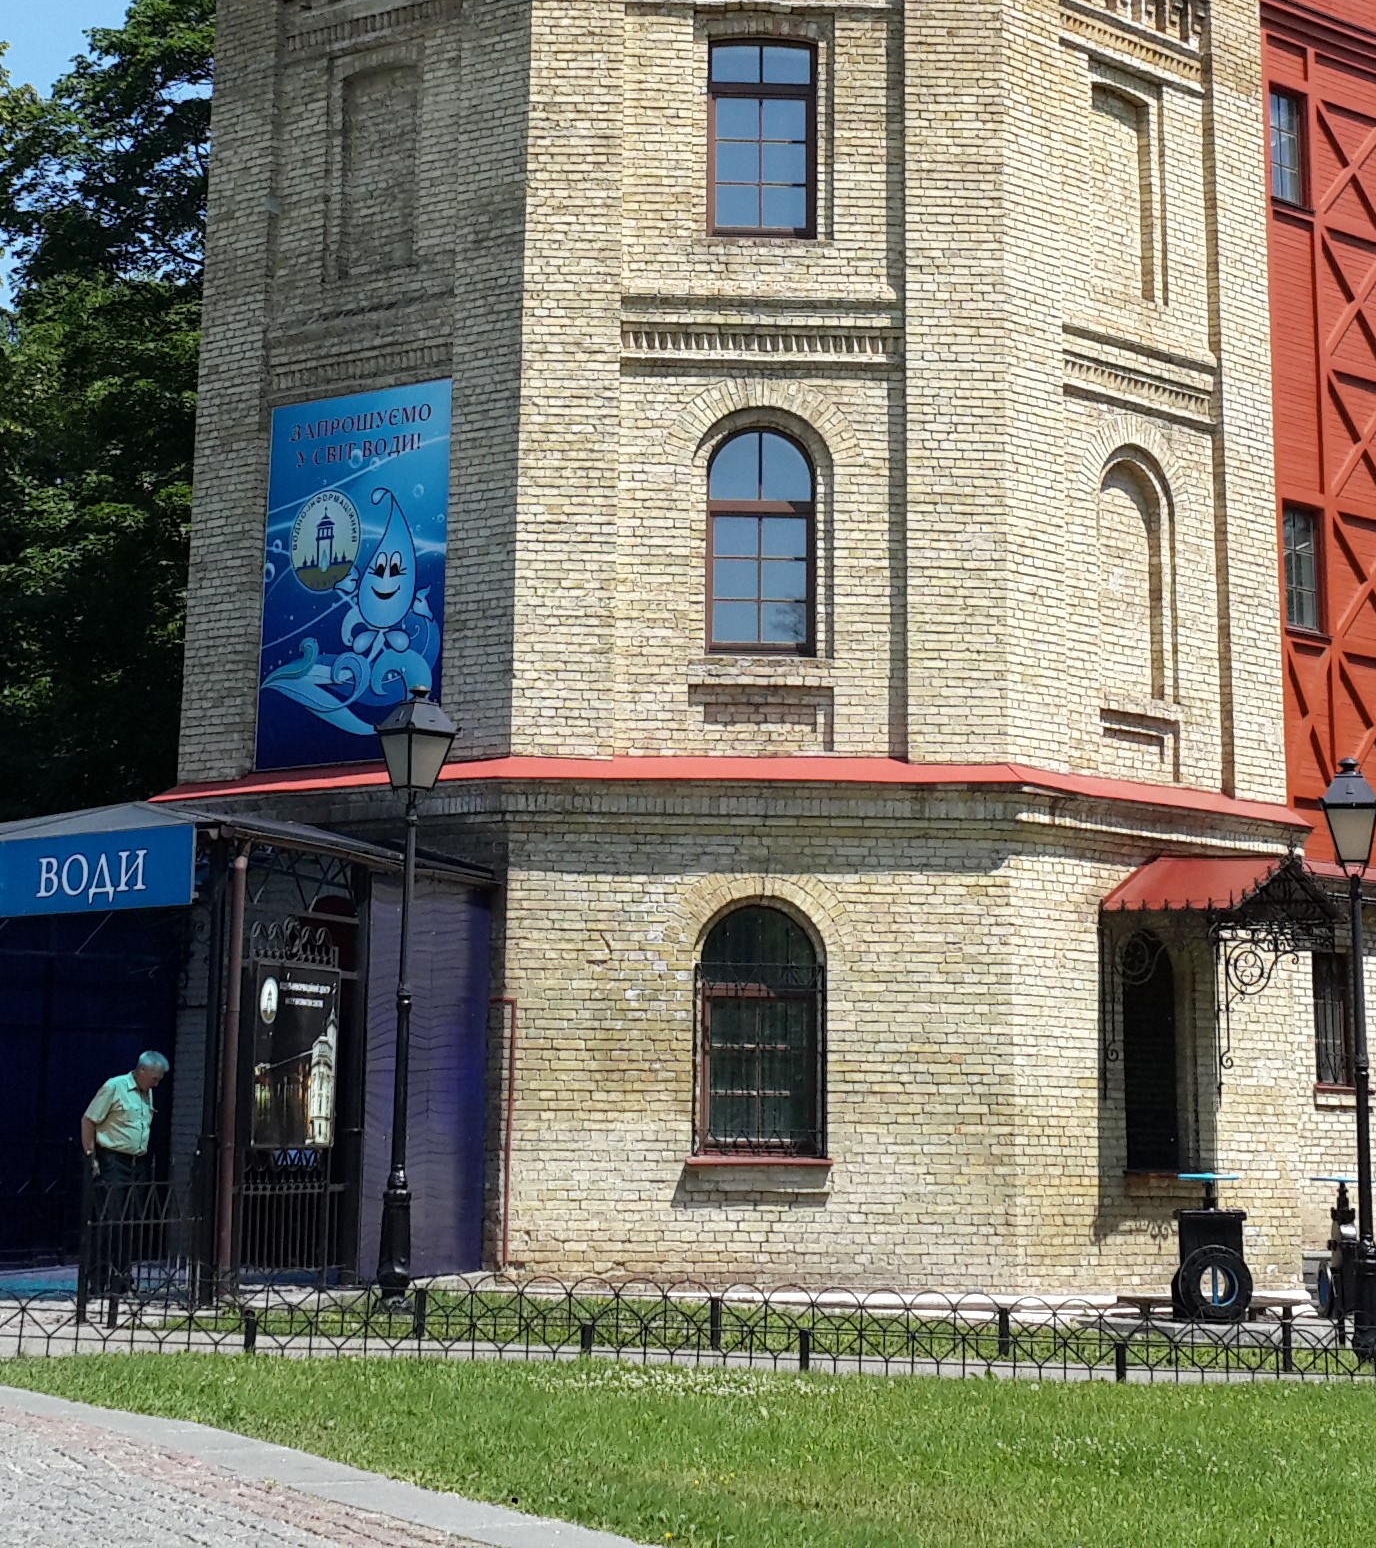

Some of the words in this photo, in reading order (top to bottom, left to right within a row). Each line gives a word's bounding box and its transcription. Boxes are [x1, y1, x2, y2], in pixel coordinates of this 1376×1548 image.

[289, 403, 432, 442] ЗАПРОШУЄМО
[296, 450, 306, 468] У
[313, 442, 356, 465] СВІТ
[362, 432, 422, 458] ВОДИ!
[35, 849, 148, 905] ВОДИ
